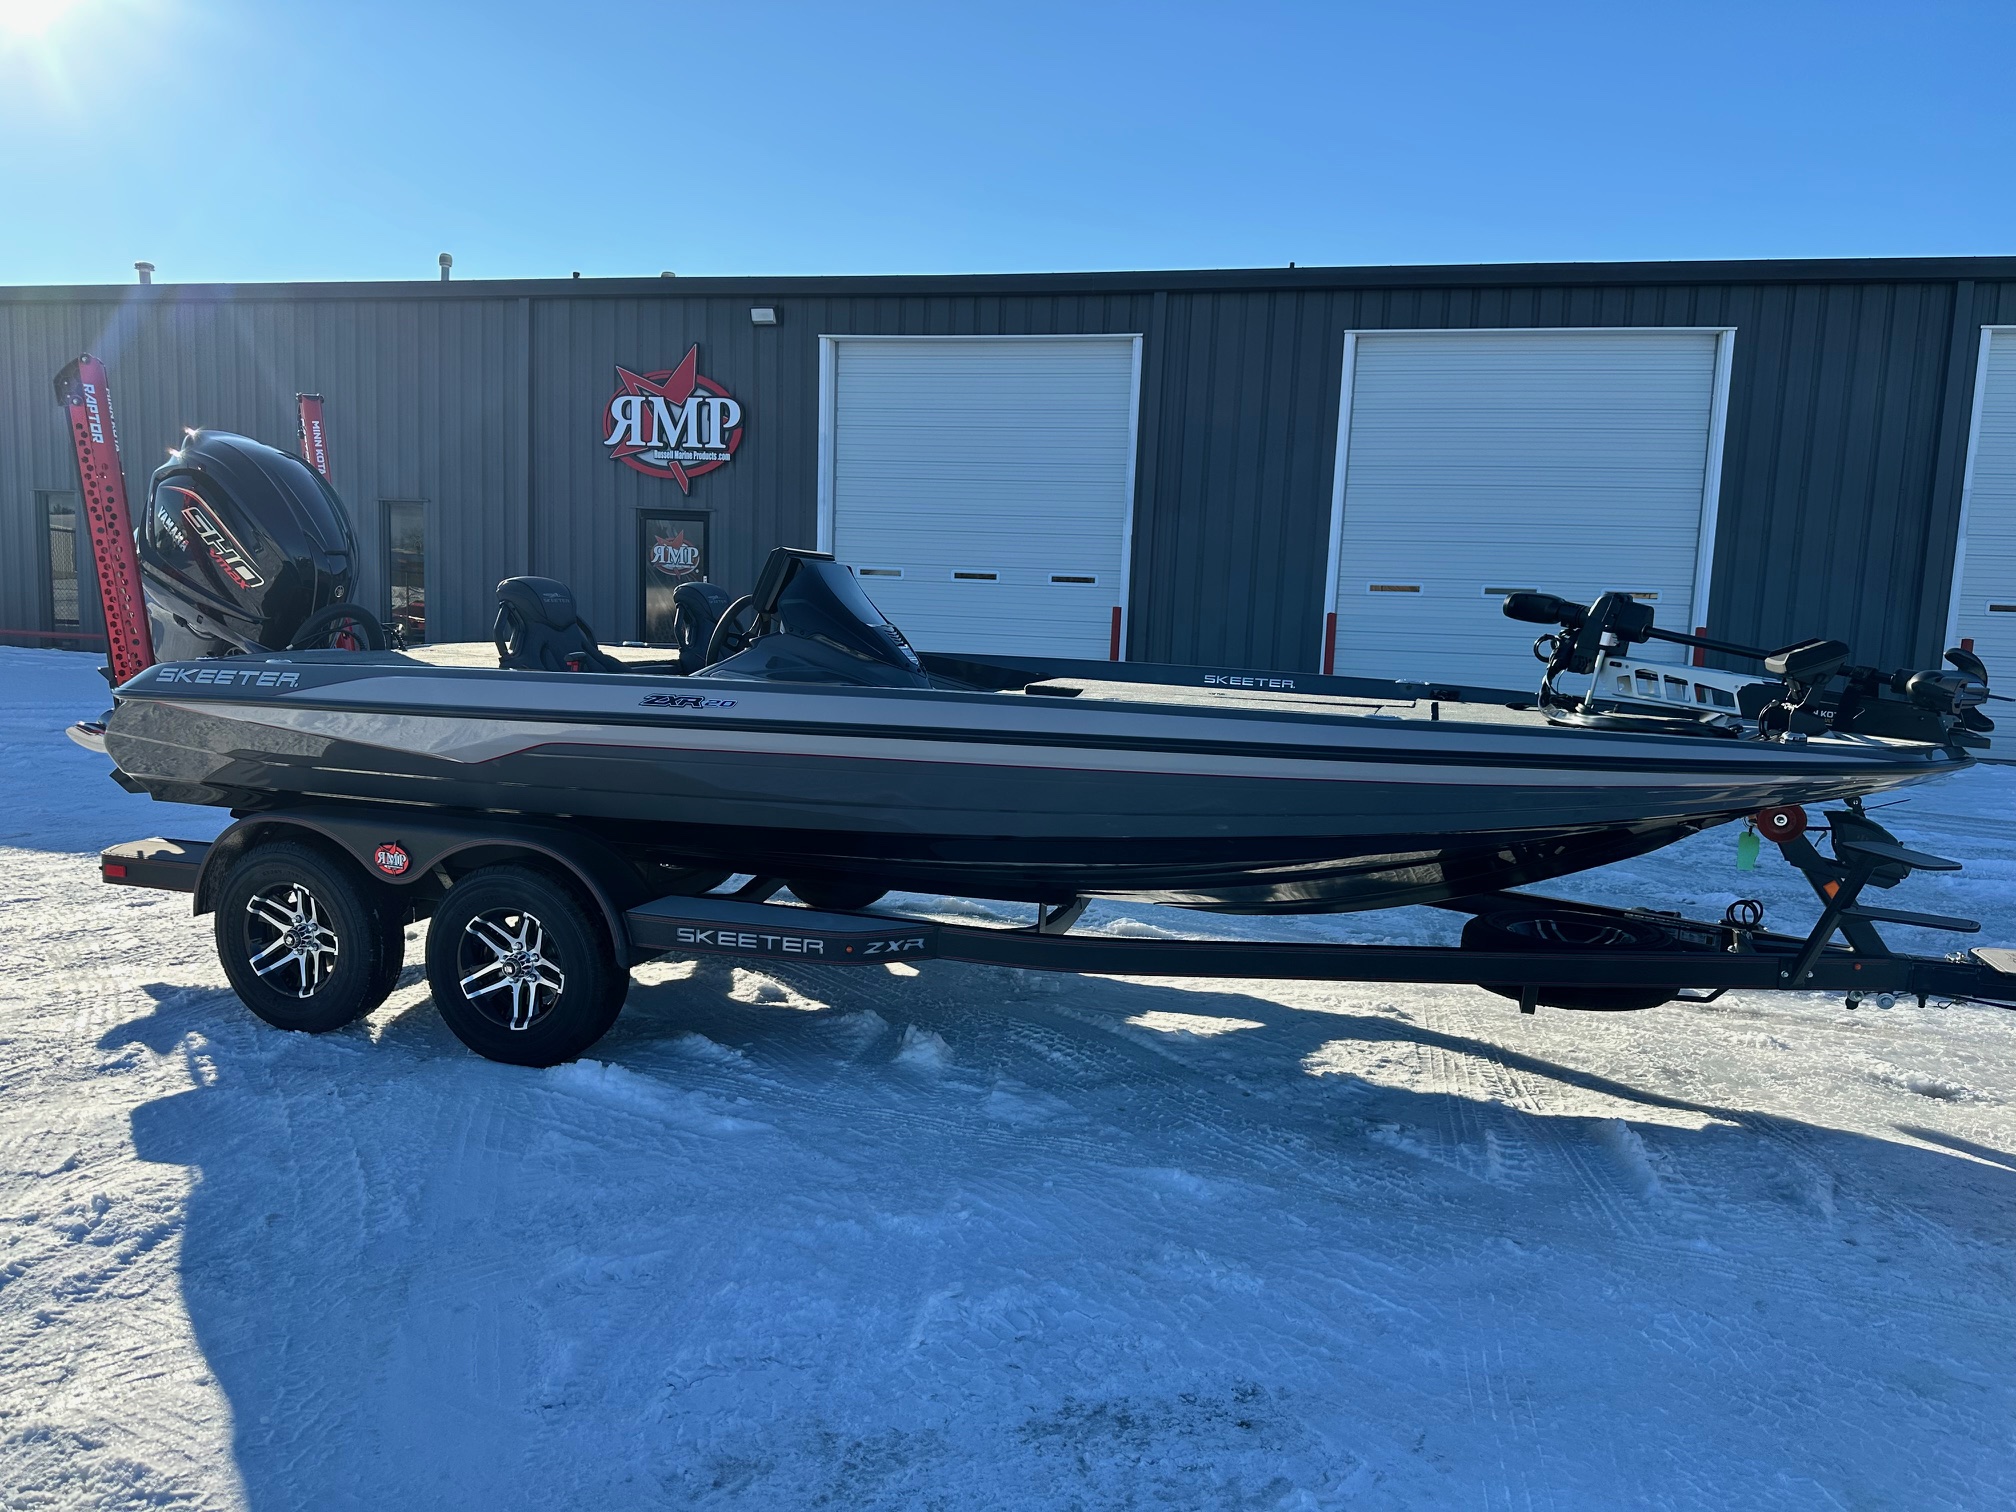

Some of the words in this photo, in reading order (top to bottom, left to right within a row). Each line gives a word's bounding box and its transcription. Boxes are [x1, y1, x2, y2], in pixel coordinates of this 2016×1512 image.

[83, 383, 104, 443] RAPTOR
[311, 420, 323, 448] MINN
[315, 449, 327, 475] KOTA
[653, 450, 674, 460] Russell
[674, 450, 693, 460] Marine
[157, 505, 190, 552] YAMAHA
[181, 506, 265, 588] SHO
[155, 667, 301, 688] SKEETER
[1203, 674, 1296, 689] SKEETER
[676, 927, 825, 955] SKEETER
[862, 937, 926, 955] ZXR
